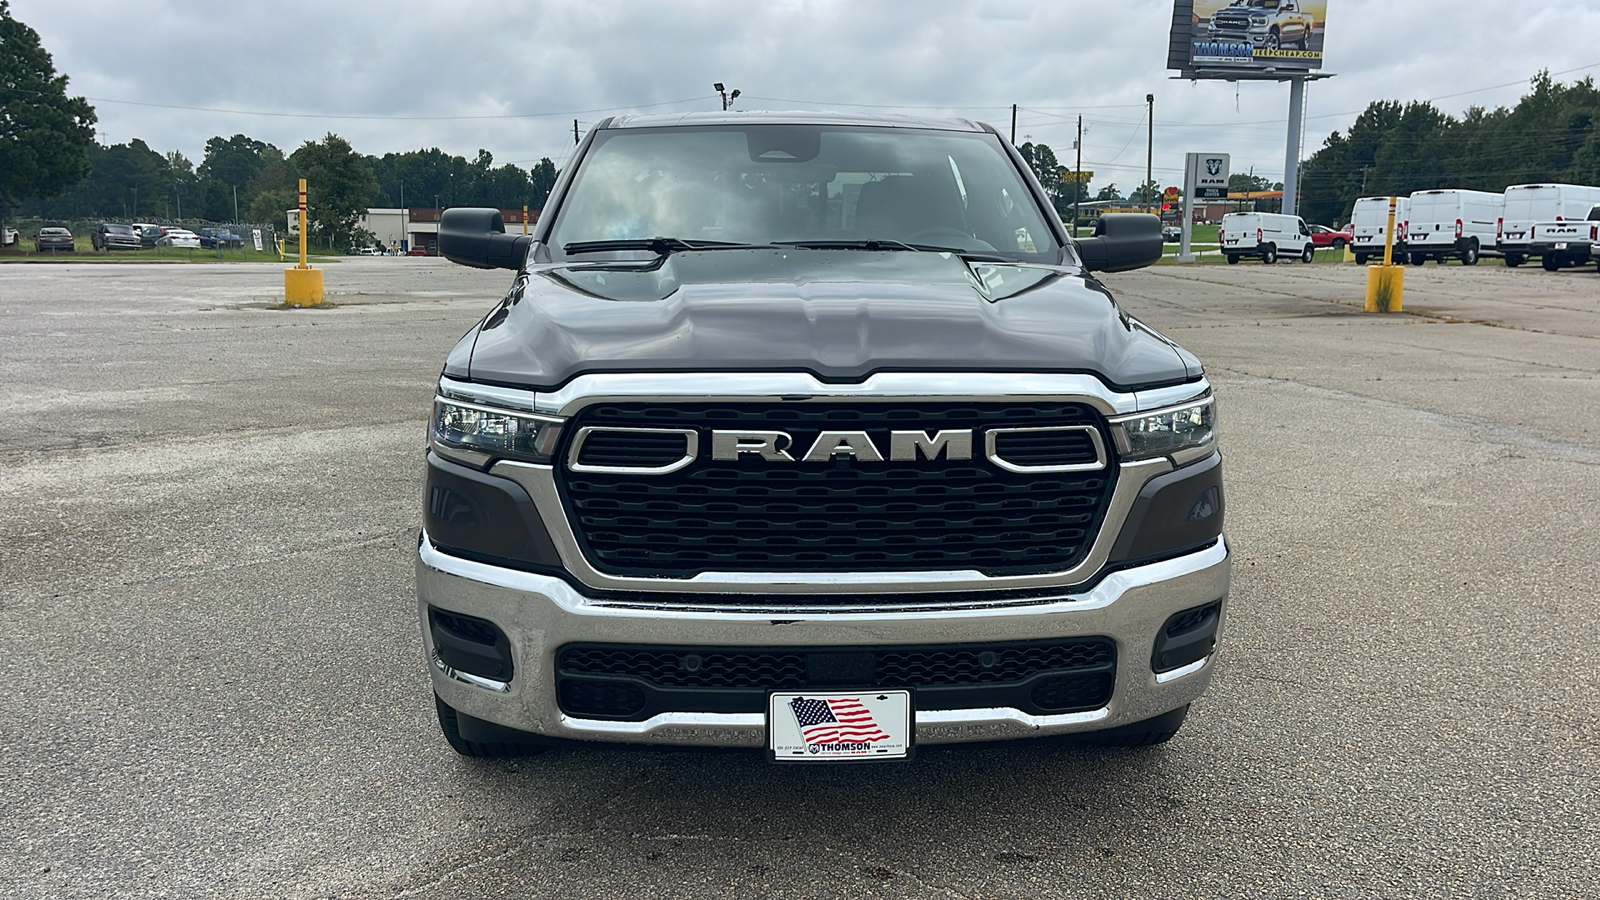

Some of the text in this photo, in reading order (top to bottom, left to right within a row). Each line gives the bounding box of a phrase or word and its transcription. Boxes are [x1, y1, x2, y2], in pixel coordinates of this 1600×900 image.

[1193, 42, 1254, 56] THOMSON
[712, 429, 973, 462] RAM
[820, 743, 871, 751] THOMSON
